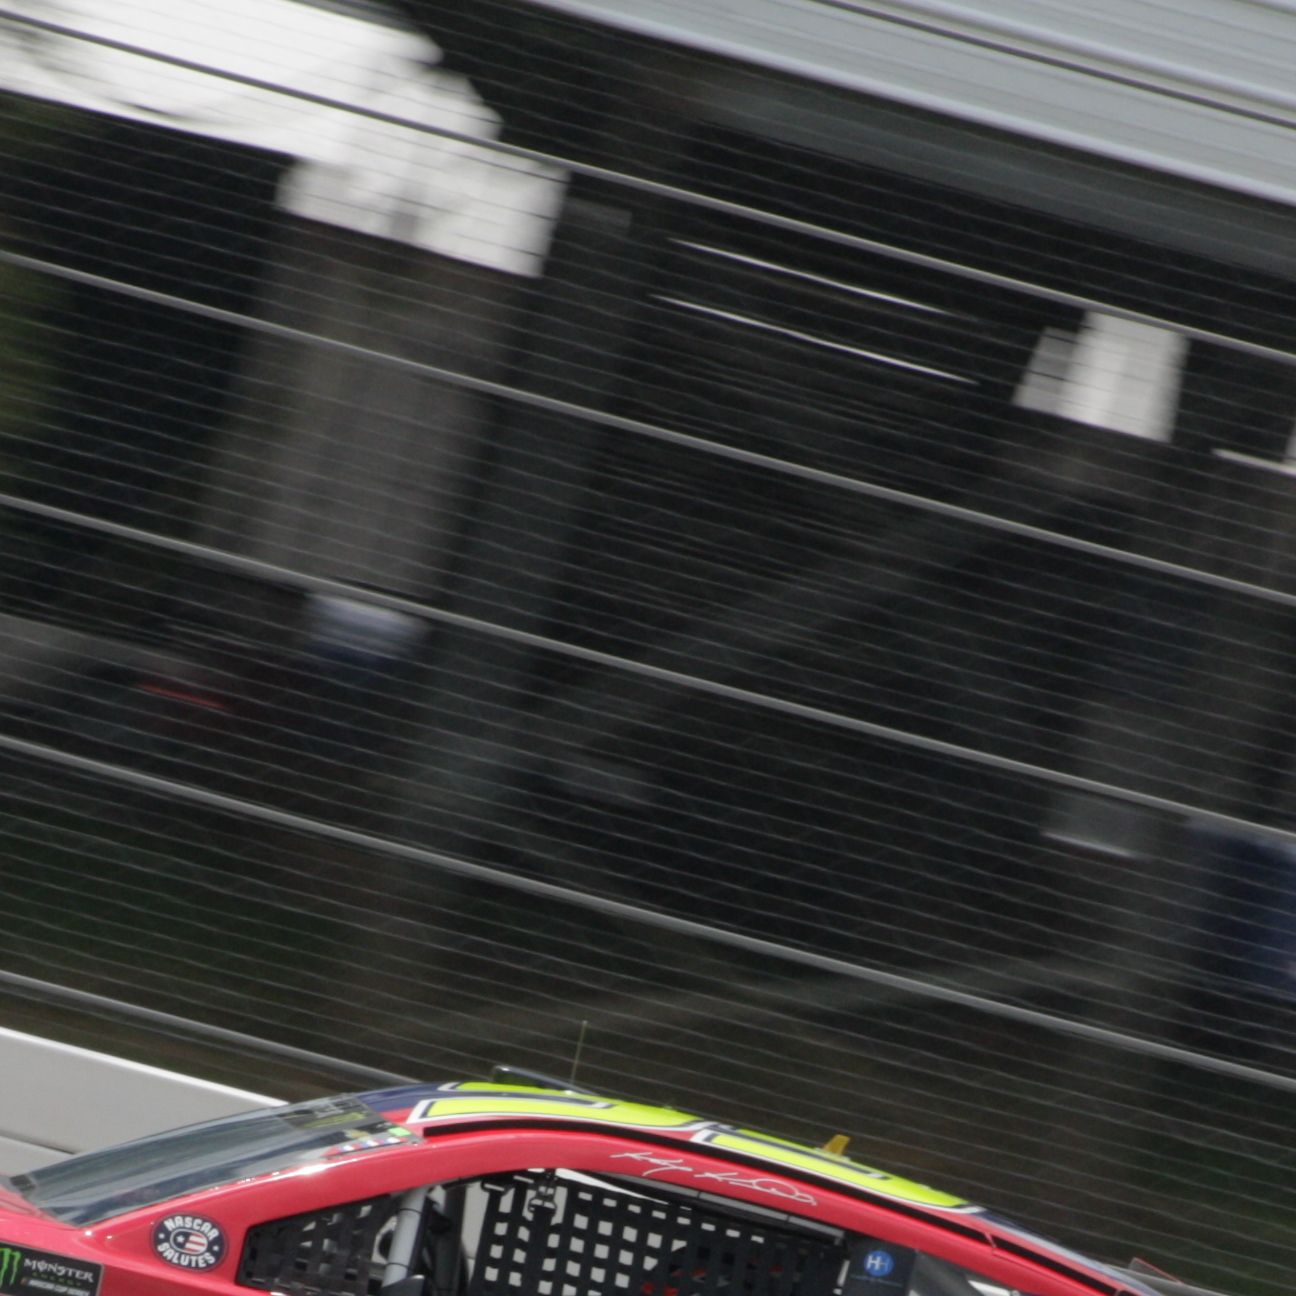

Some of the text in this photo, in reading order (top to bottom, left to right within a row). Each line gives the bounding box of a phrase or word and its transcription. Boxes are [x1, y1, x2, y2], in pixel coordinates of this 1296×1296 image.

[164, 1215, 219, 1240] NASCAR
[157, 1242, 216, 1268] SALUTES
[23, 1258, 94, 1282] MONSTER
